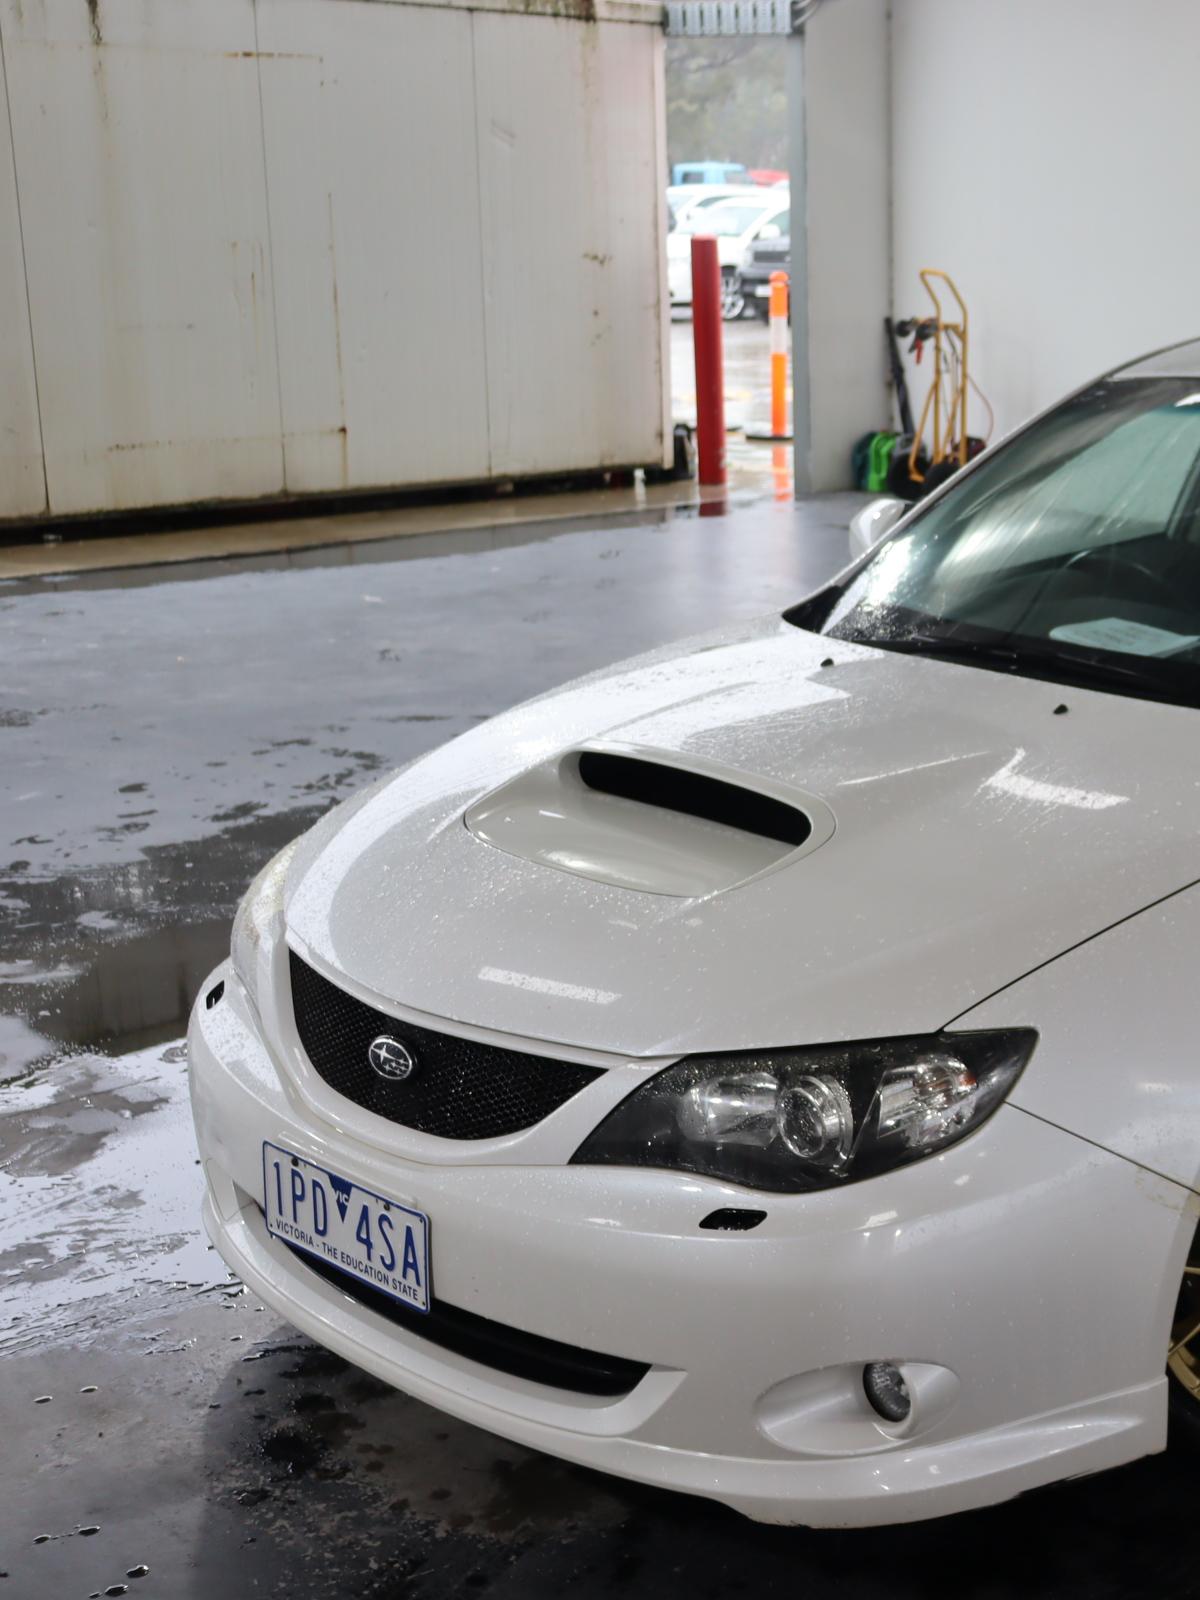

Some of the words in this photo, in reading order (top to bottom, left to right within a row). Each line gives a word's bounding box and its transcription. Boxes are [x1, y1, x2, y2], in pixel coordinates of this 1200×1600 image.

[273, 1160, 328, 1237] 1PD
[355, 1203, 422, 1288] 4SA
[334, 1189, 350, 1206] VIC
[275, 1218, 314, 1246] VICTORIA
[321, 1241, 339, 1260] THE
[340, 1253, 389, 1287] EDUCATION
[392, 1279, 418, 1301] STATE
